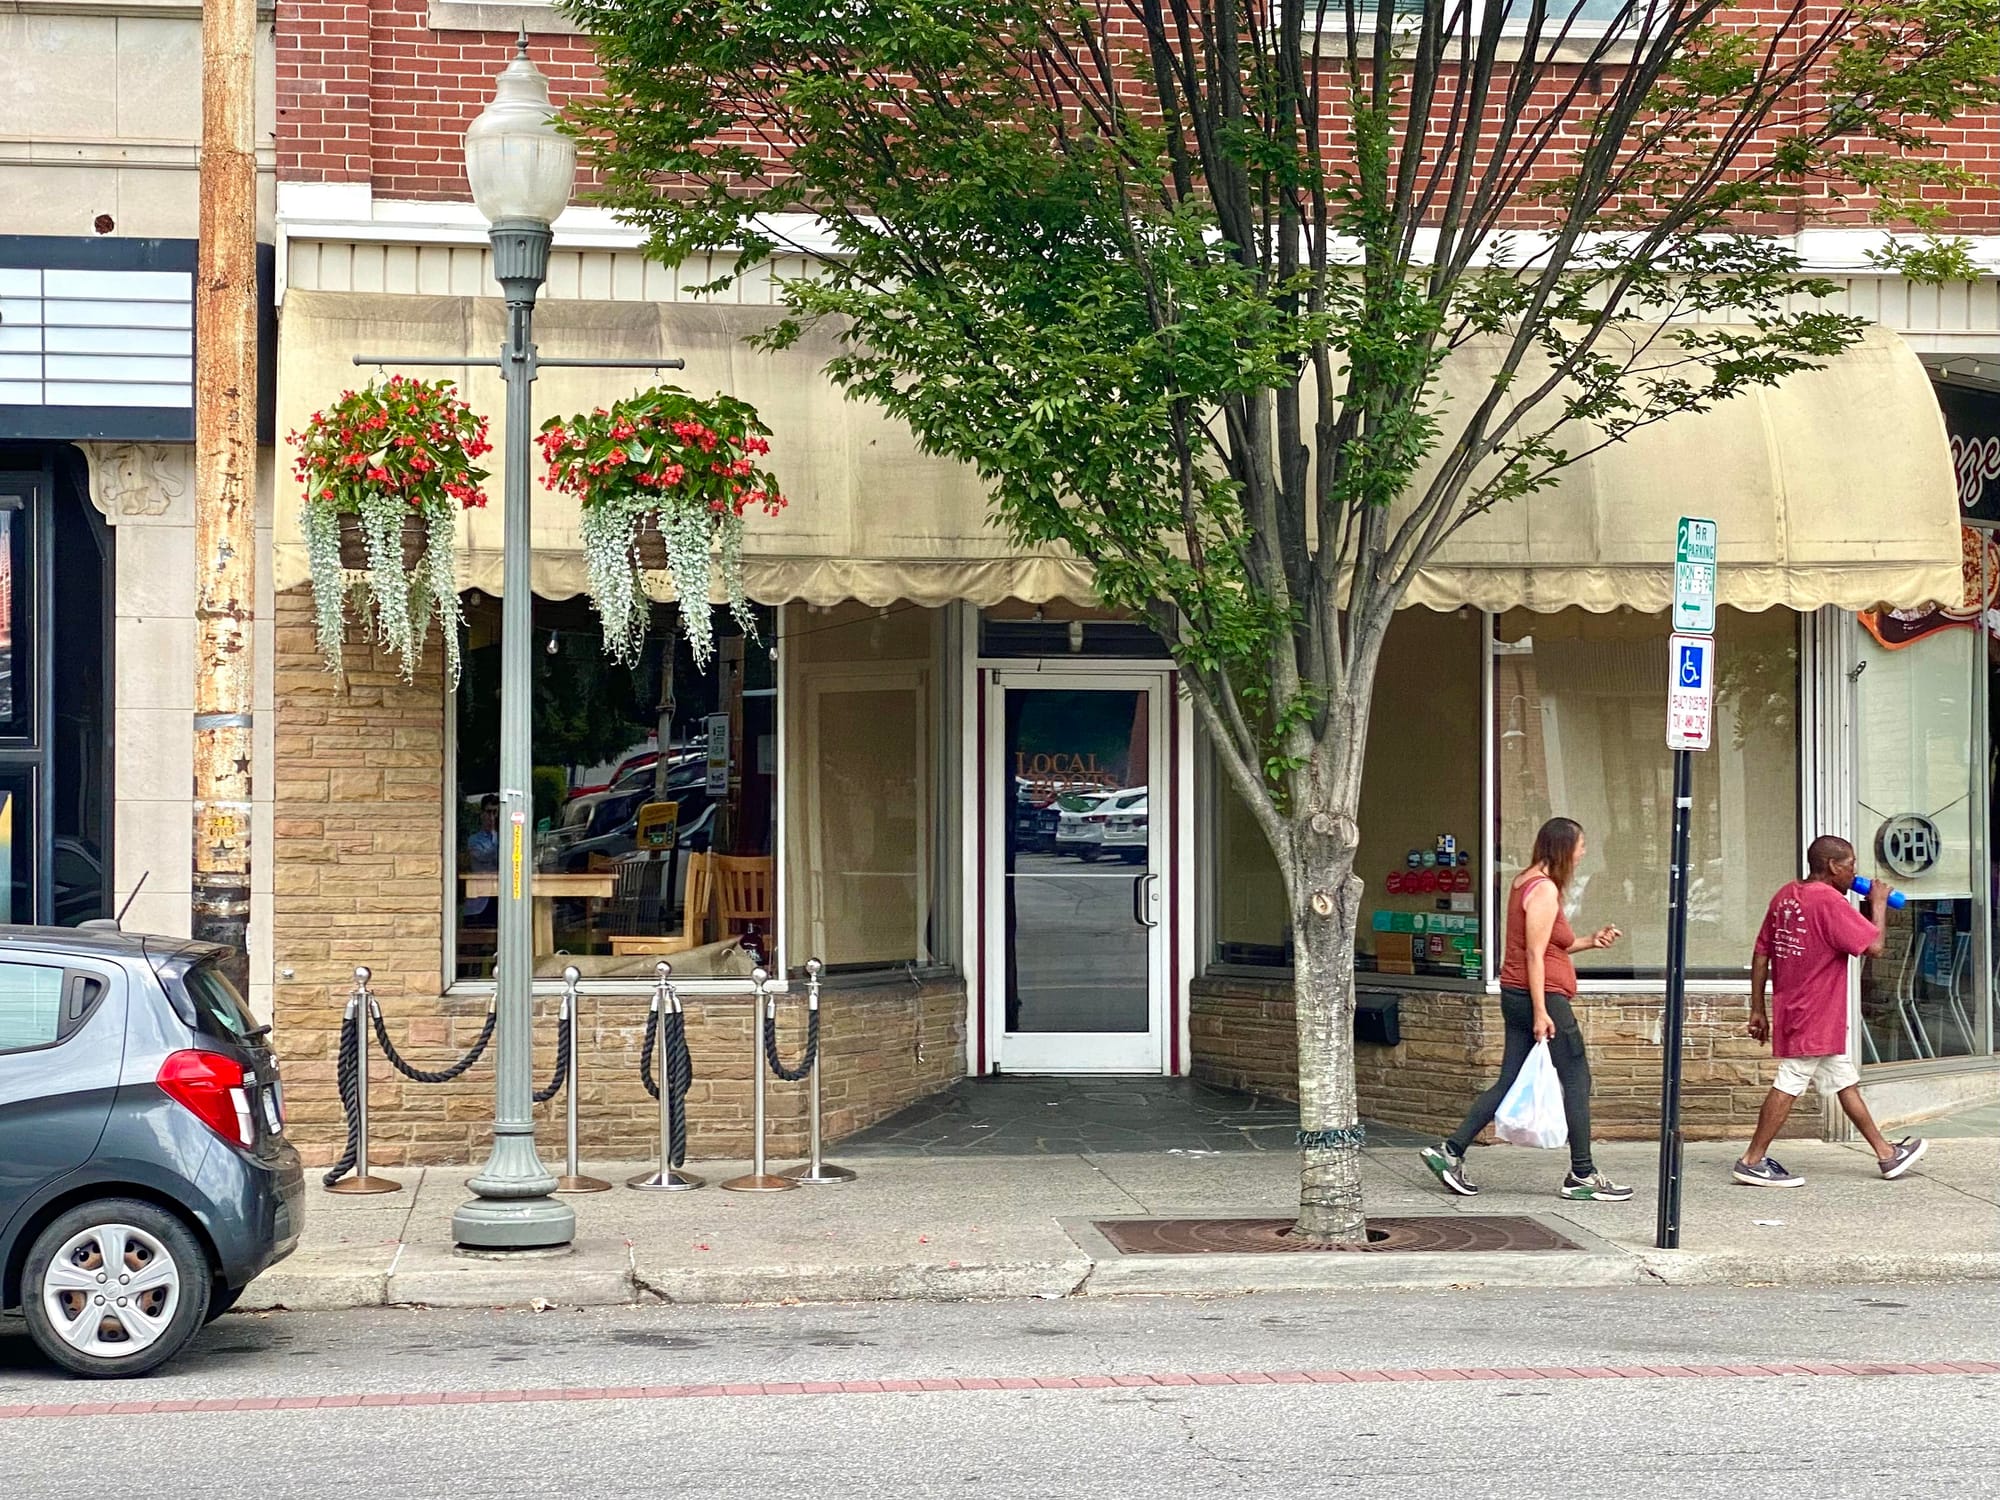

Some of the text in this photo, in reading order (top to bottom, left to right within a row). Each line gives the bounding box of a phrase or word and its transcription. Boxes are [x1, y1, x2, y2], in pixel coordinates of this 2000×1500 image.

[1678, 525, 1707, 554] 2 HR
[1687, 543, 1714, 560] PARKING
[1679, 564, 1695, 579] MON
[1015, 751, 1105, 778] LOCAL
[1884, 826, 1941, 863] OPEN
